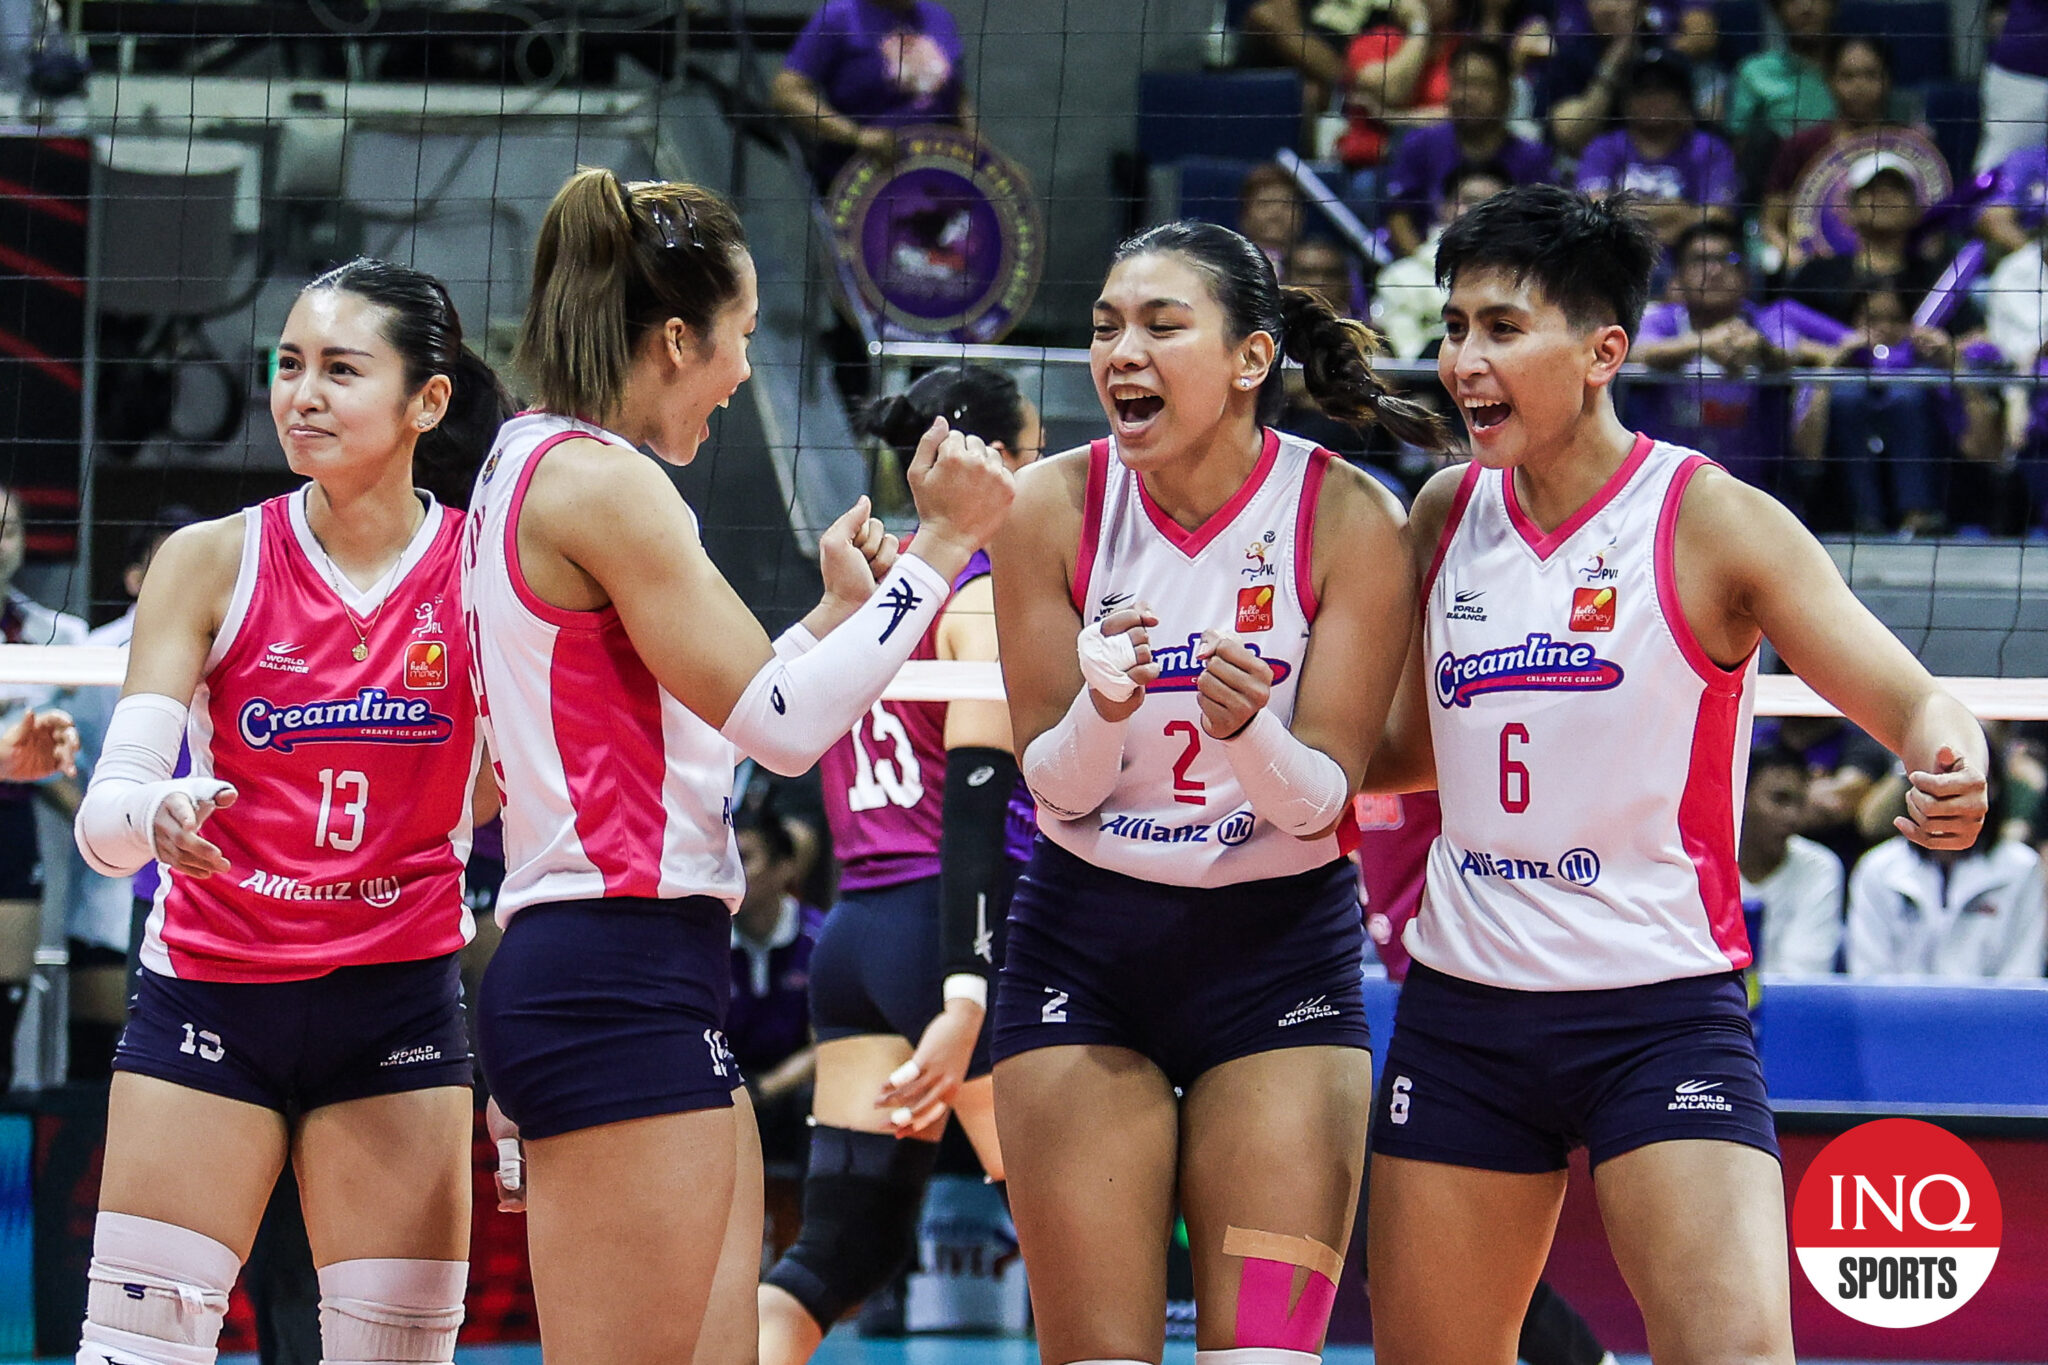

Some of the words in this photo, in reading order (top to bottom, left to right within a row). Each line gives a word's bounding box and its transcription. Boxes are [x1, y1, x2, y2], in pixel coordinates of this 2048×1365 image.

[1239, 613, 1270, 625] money
[1572, 613, 1611, 626] money
[259, 660, 310, 674] BALANCE
[266, 654, 305, 666] WORLD
[410, 670, 443, 681] money
[1437, 637, 1591, 705] Creamline
[1526, 675, 1558, 683] CREAMY
[1574, 675, 1603, 683] CREAM
[241, 692, 426, 746] Creamline
[360, 728, 394, 736] CREAMY
[396, 729, 410, 737] ICE
[1163, 720, 1206, 791] 2
[1500, 722, 1531, 814] 6
[314, 768, 369, 852] 13
[1098, 814, 1211, 843] Allianz
[238, 868, 352, 900] Allianz
[1041, 985, 1069, 1023] 2
[1284, 1004, 1332, 1018] WORLD
[1278, 1010, 1340, 1027] BALANCE
[1390, 1074, 1413, 1125] 6
[1675, 1094, 1726, 1103] WORLD
[1667, 1101, 1732, 1112] BALANCE
